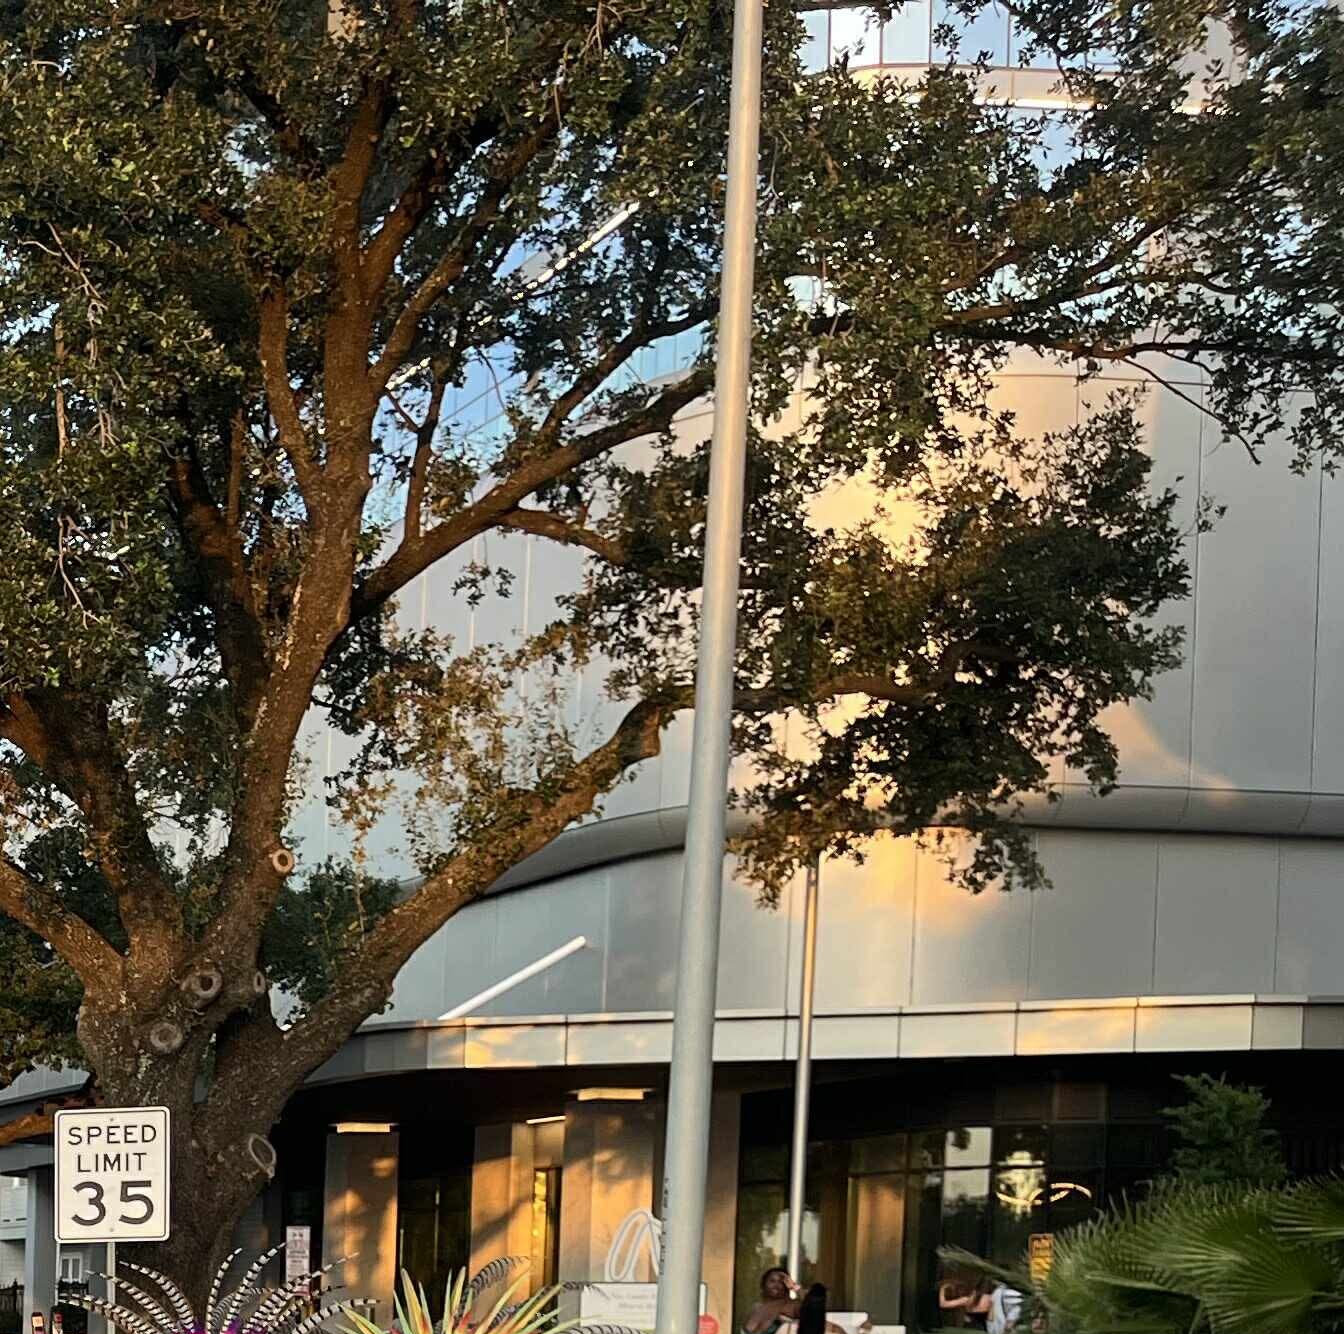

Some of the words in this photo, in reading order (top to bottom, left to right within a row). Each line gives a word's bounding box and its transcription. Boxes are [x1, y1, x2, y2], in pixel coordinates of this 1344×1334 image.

[67, 1124, 157, 1146] SPEED
[77, 1152, 147, 1173] LIMIT
[70, 1180, 155, 1227] 35
